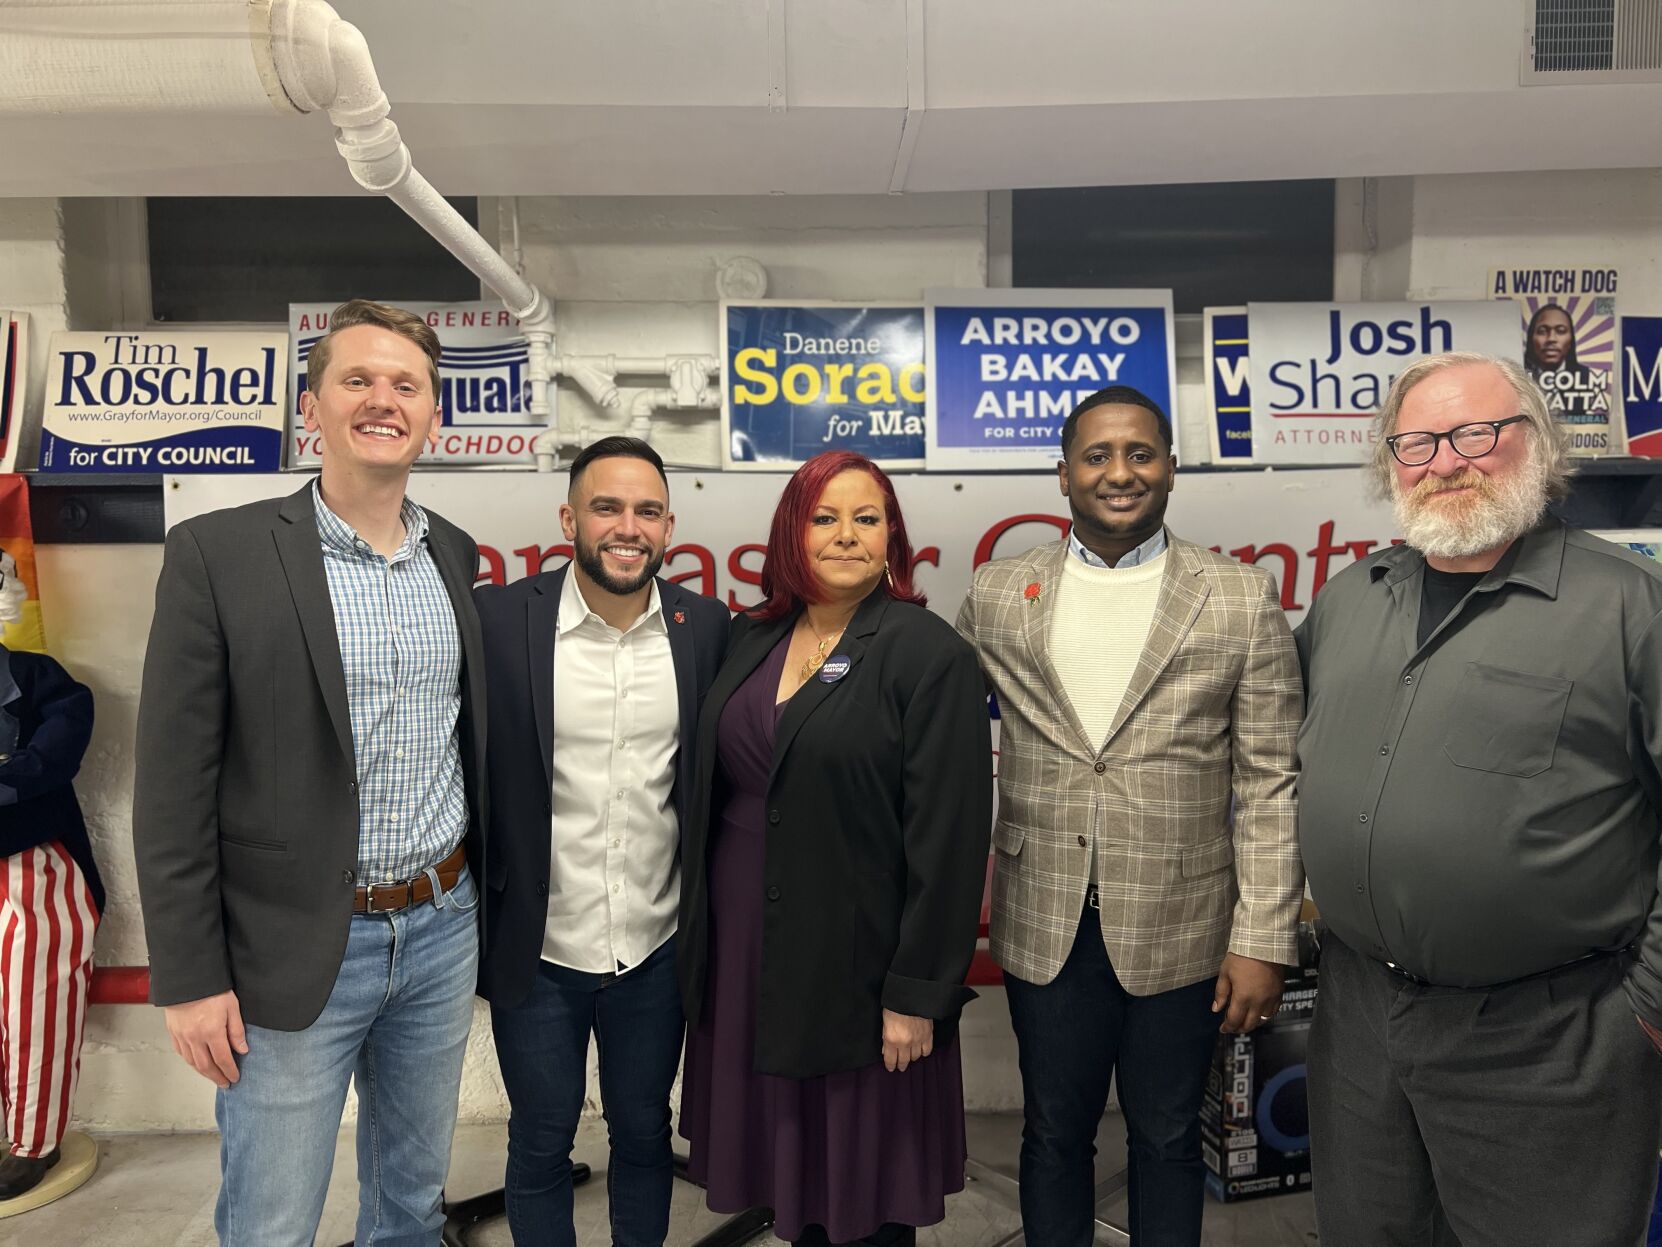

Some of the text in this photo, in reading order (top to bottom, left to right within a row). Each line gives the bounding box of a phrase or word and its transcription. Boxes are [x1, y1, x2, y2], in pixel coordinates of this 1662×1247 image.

[1494, 270, 1617, 294] A WATCH DOG
[427, 311, 520, 327] GENER
[960, 317, 1140, 346] ARROYO
[783, 332, 881, 355] Danene
[1326, 306, 1452, 365] Josh
[104, 335, 180, 365] Tim
[54, 346, 277, 407] Roschel
[734, 347, 926, 405] Sorac
[980, 353, 1126, 382] BAKAY
[1625, 346, 1662, 402] M
[68, 409, 262, 424] www.GrayforMayor.org/Council
[823, 414, 862, 442] for
[984, 427, 1014, 439] FOR
[1020, 426, 1053, 438] CITY
[1275, 429, 1377, 445] ATTORNE
[1571, 433, 1608, 448] DOGS
[69, 447, 98, 466] for
[102, 447, 153, 466] CITY
[157, 446, 255, 465] COUNCIL
